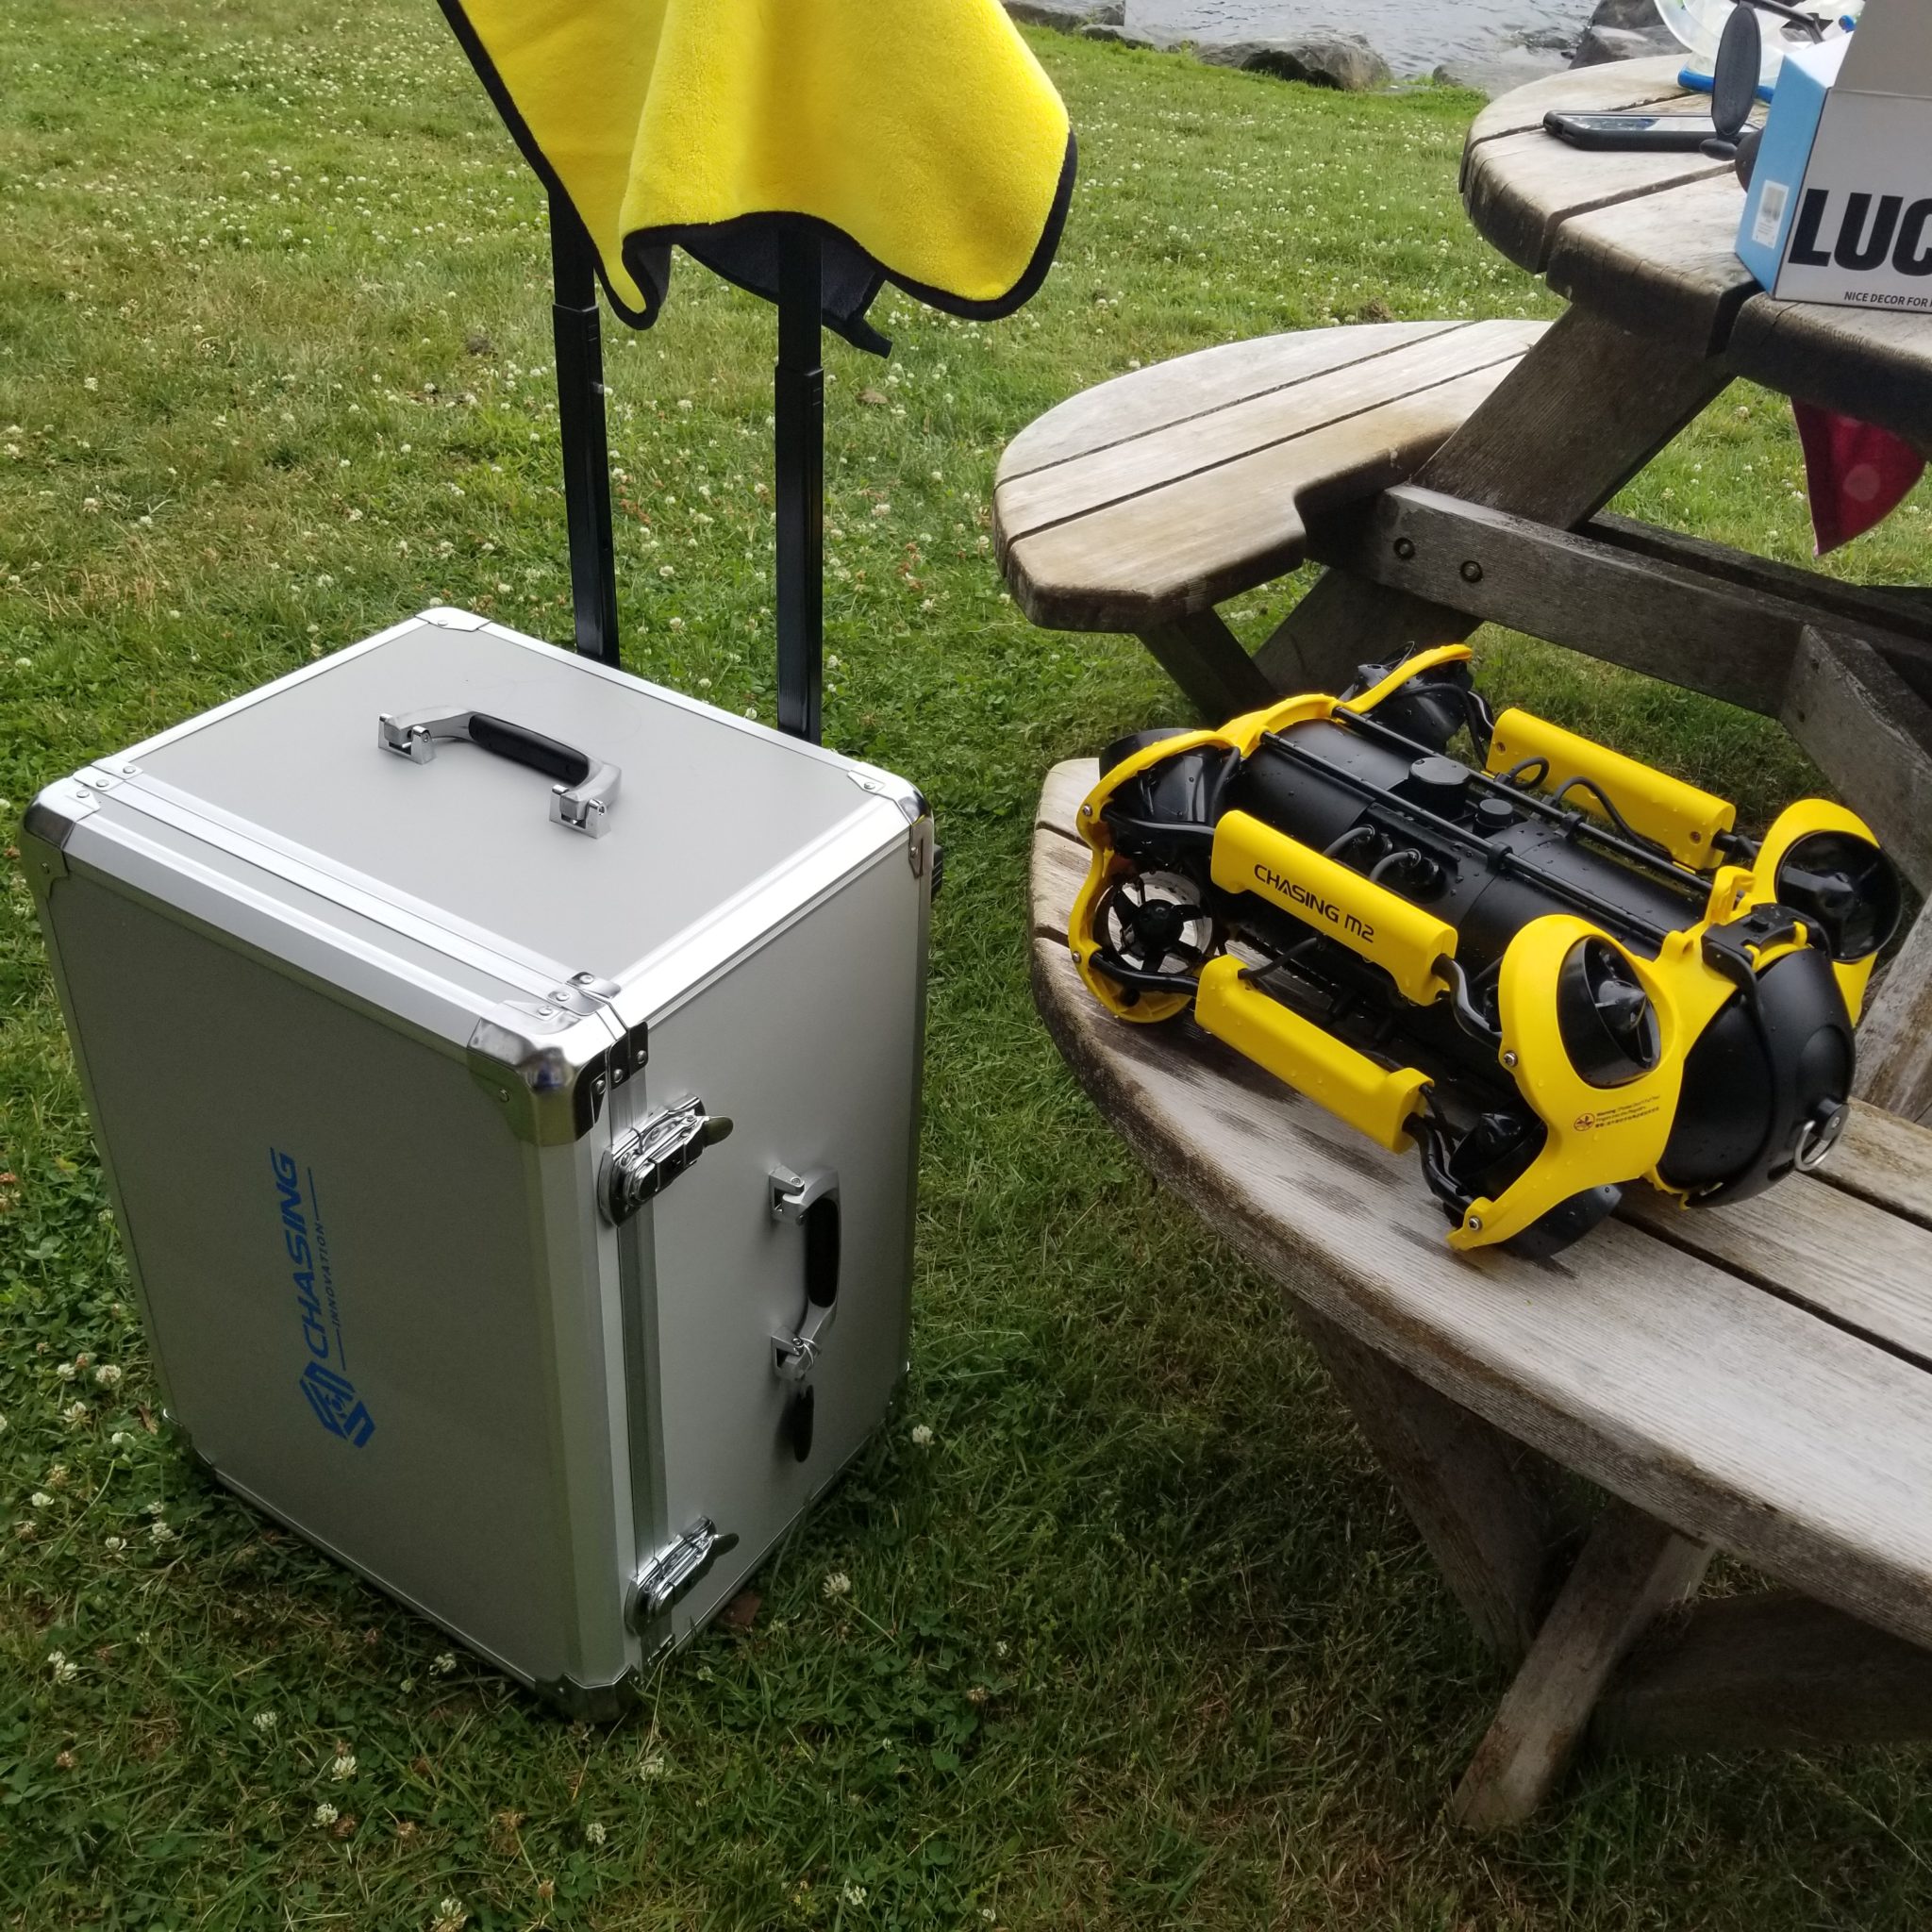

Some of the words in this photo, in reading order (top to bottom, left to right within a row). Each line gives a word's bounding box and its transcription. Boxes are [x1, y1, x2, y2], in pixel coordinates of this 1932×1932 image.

[1788, 188, 1932, 276] LUC
[1844, 291, 1869, 302] NICE
[1870, 293, 1906, 306] DECOR
[1907, 296, 1928, 308] FOR
[1254, 863, 1341, 924] CHASING
[270, 1146, 329, 1359] CHASING
[314, 1221, 341, 1328] INNOVATION
